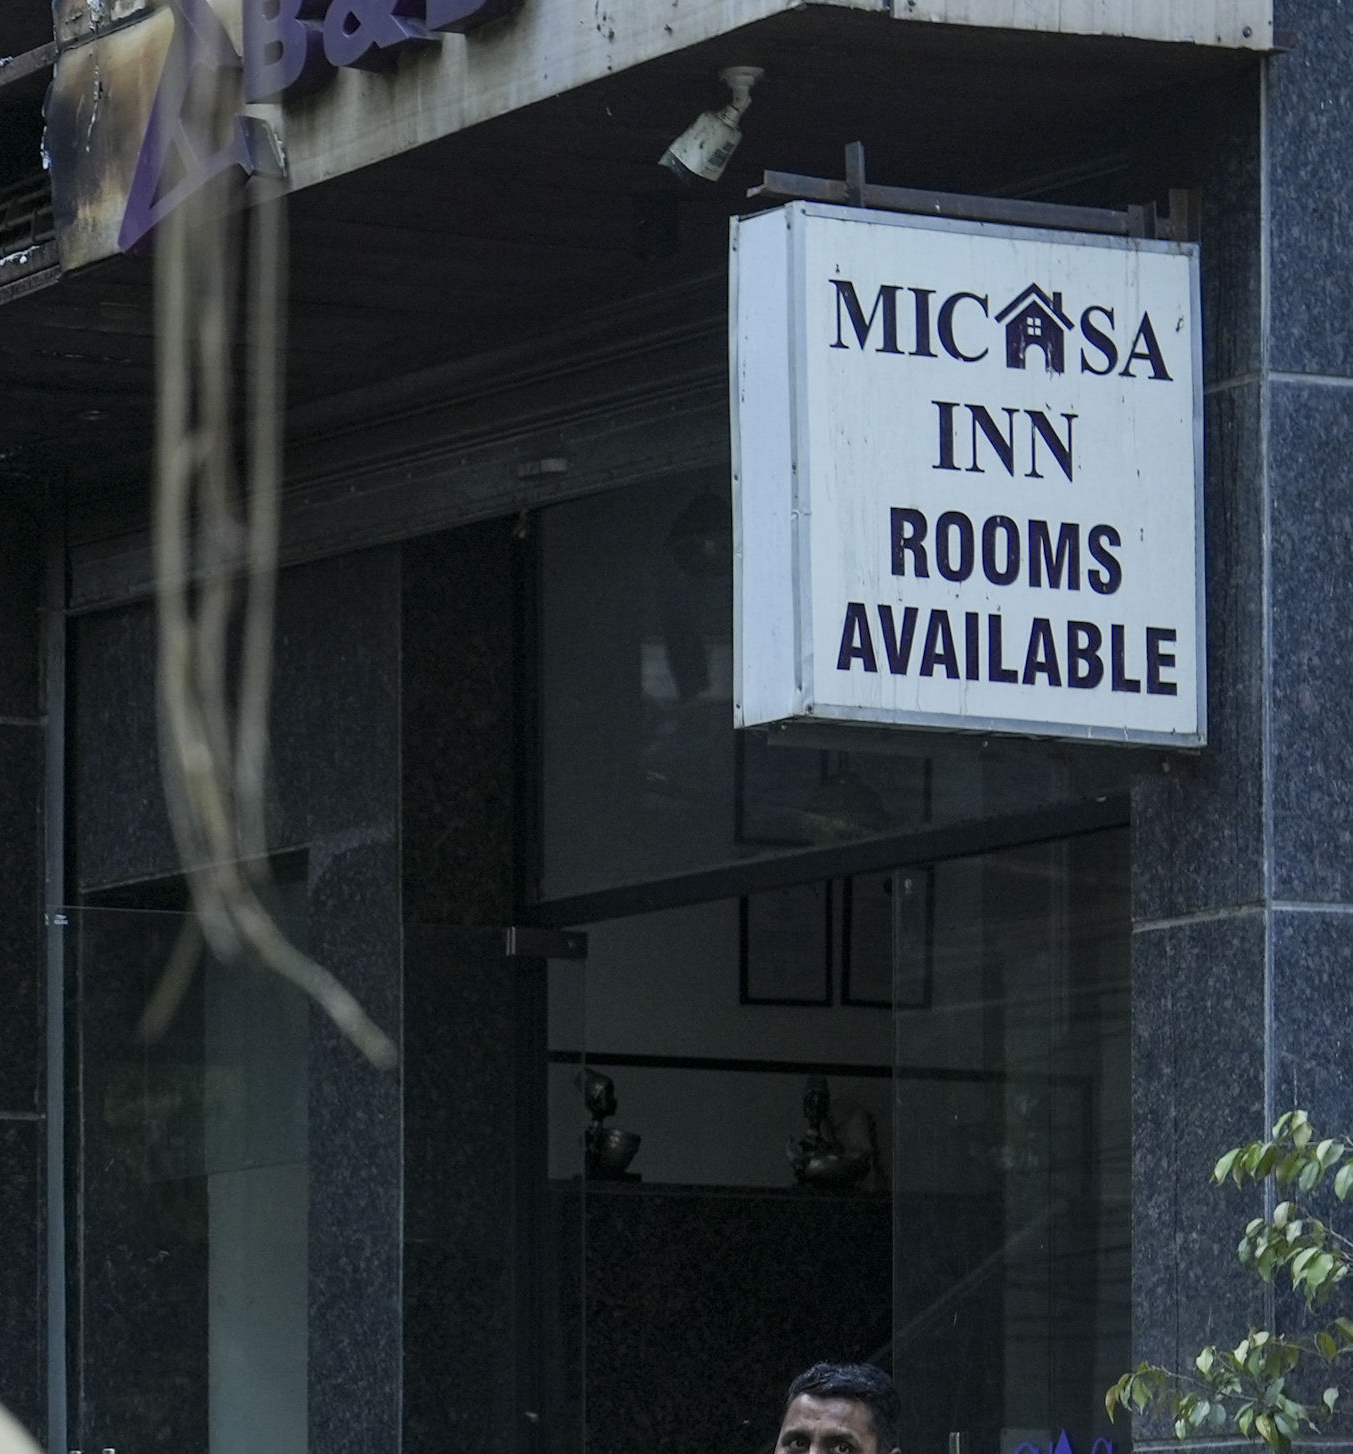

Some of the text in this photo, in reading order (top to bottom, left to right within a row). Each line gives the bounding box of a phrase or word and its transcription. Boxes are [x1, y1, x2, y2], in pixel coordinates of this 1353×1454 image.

[931, 399, 1079, 483] INN
[889, 505, 1123, 596] ROOMS
[836, 601, 1179, 697] AVAILABLE
